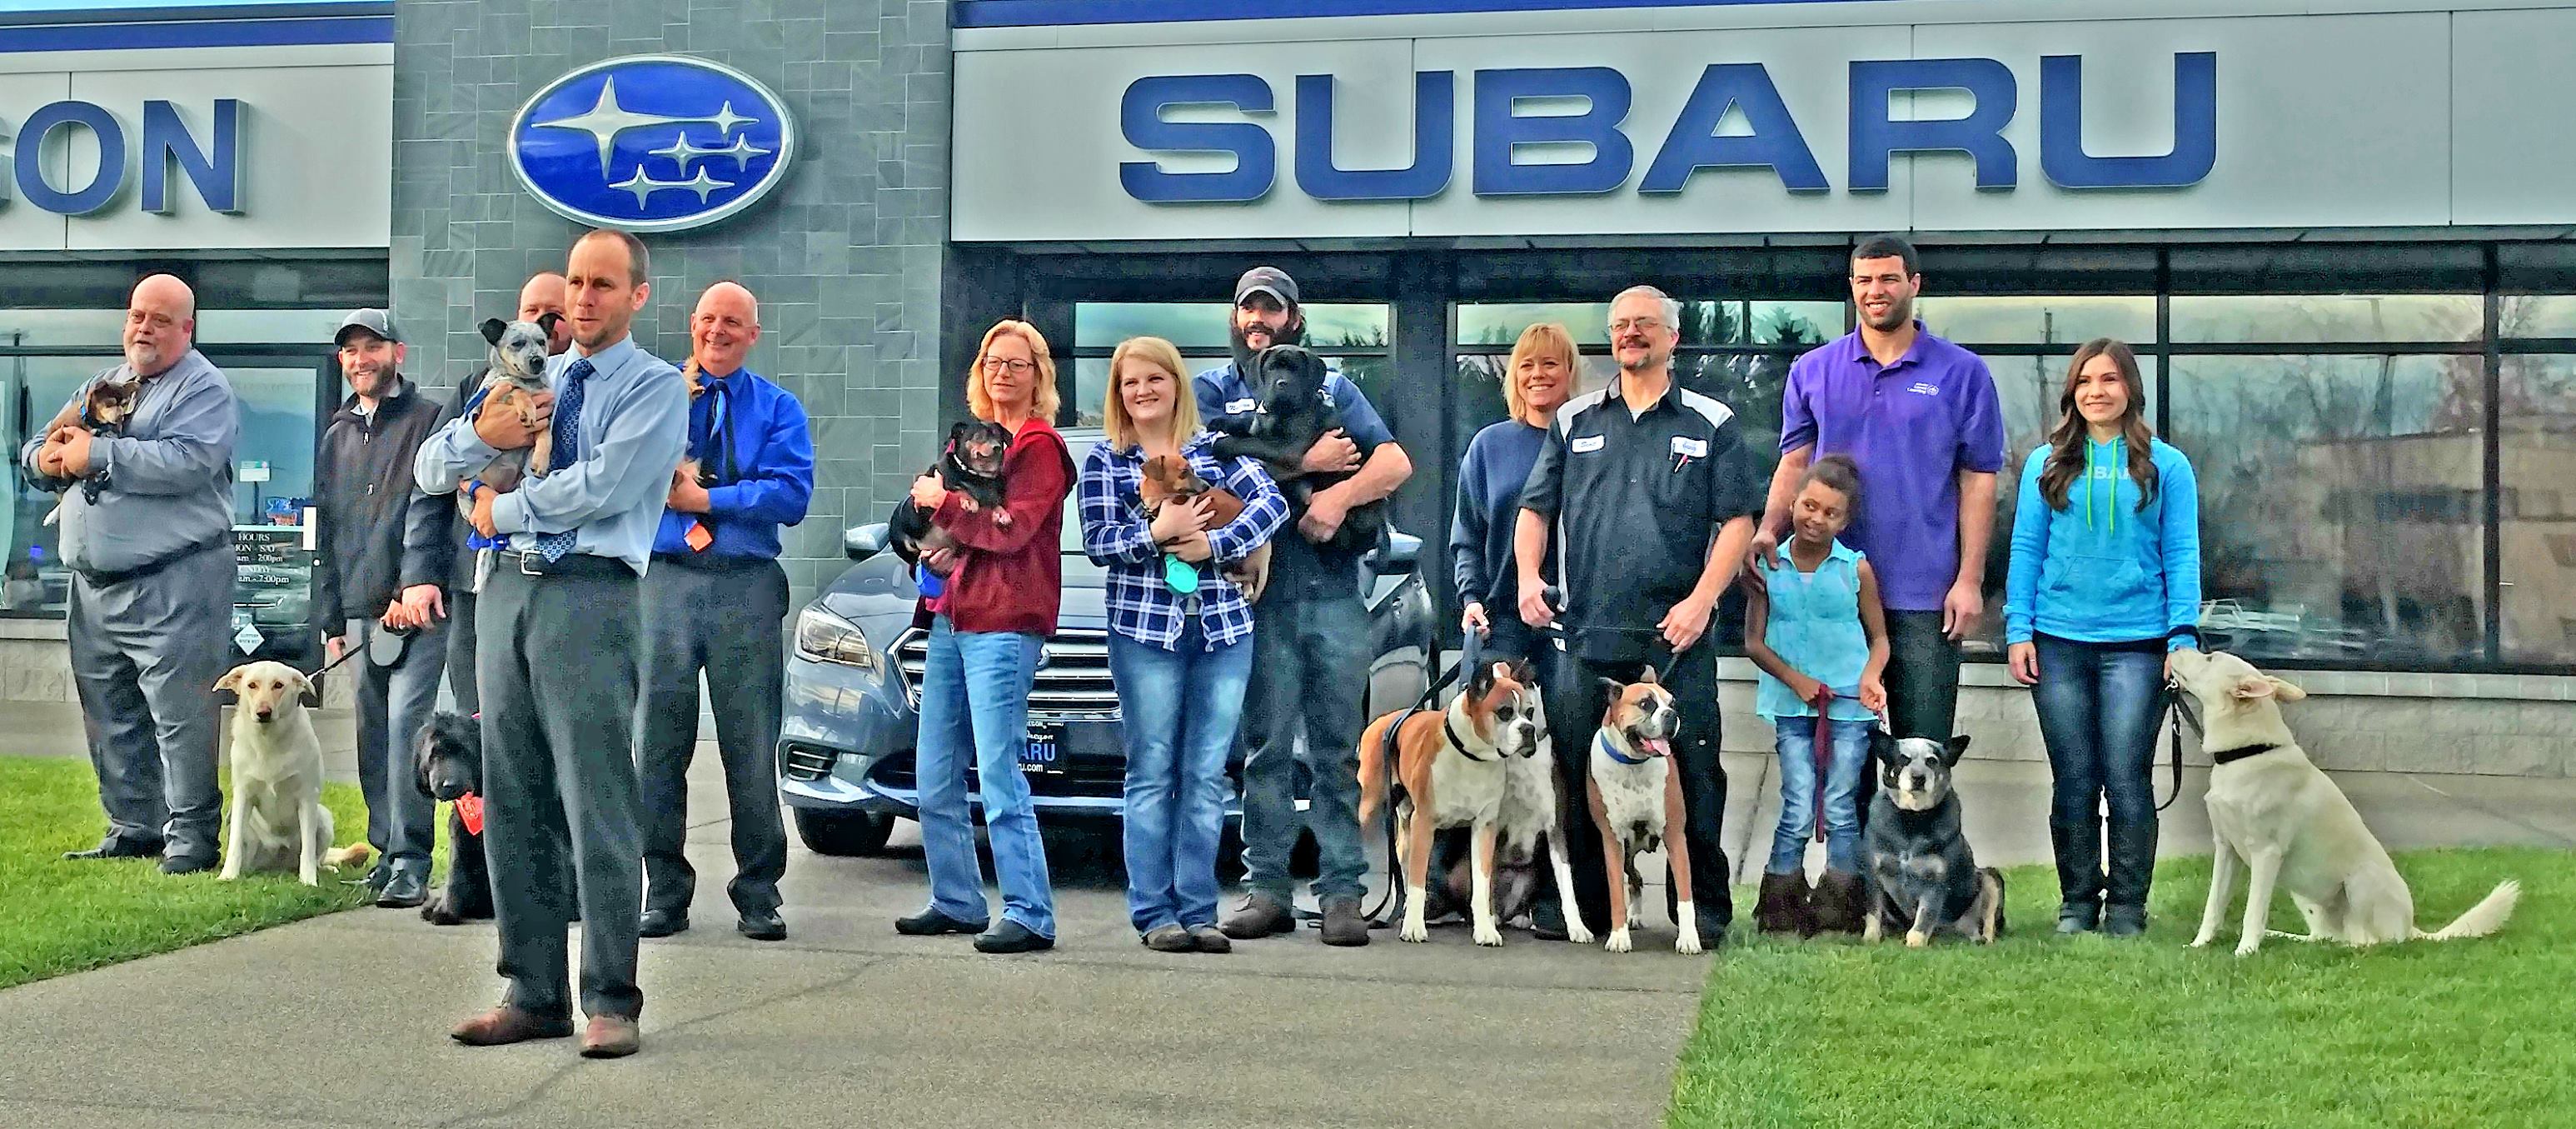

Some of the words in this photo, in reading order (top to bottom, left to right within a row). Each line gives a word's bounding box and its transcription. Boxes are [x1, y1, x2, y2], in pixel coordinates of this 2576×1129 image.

[0, 98, 248, 217] ON
[1119, 52, 2217, 203] SUBARU
[238, 532, 272, 542] HOURS
